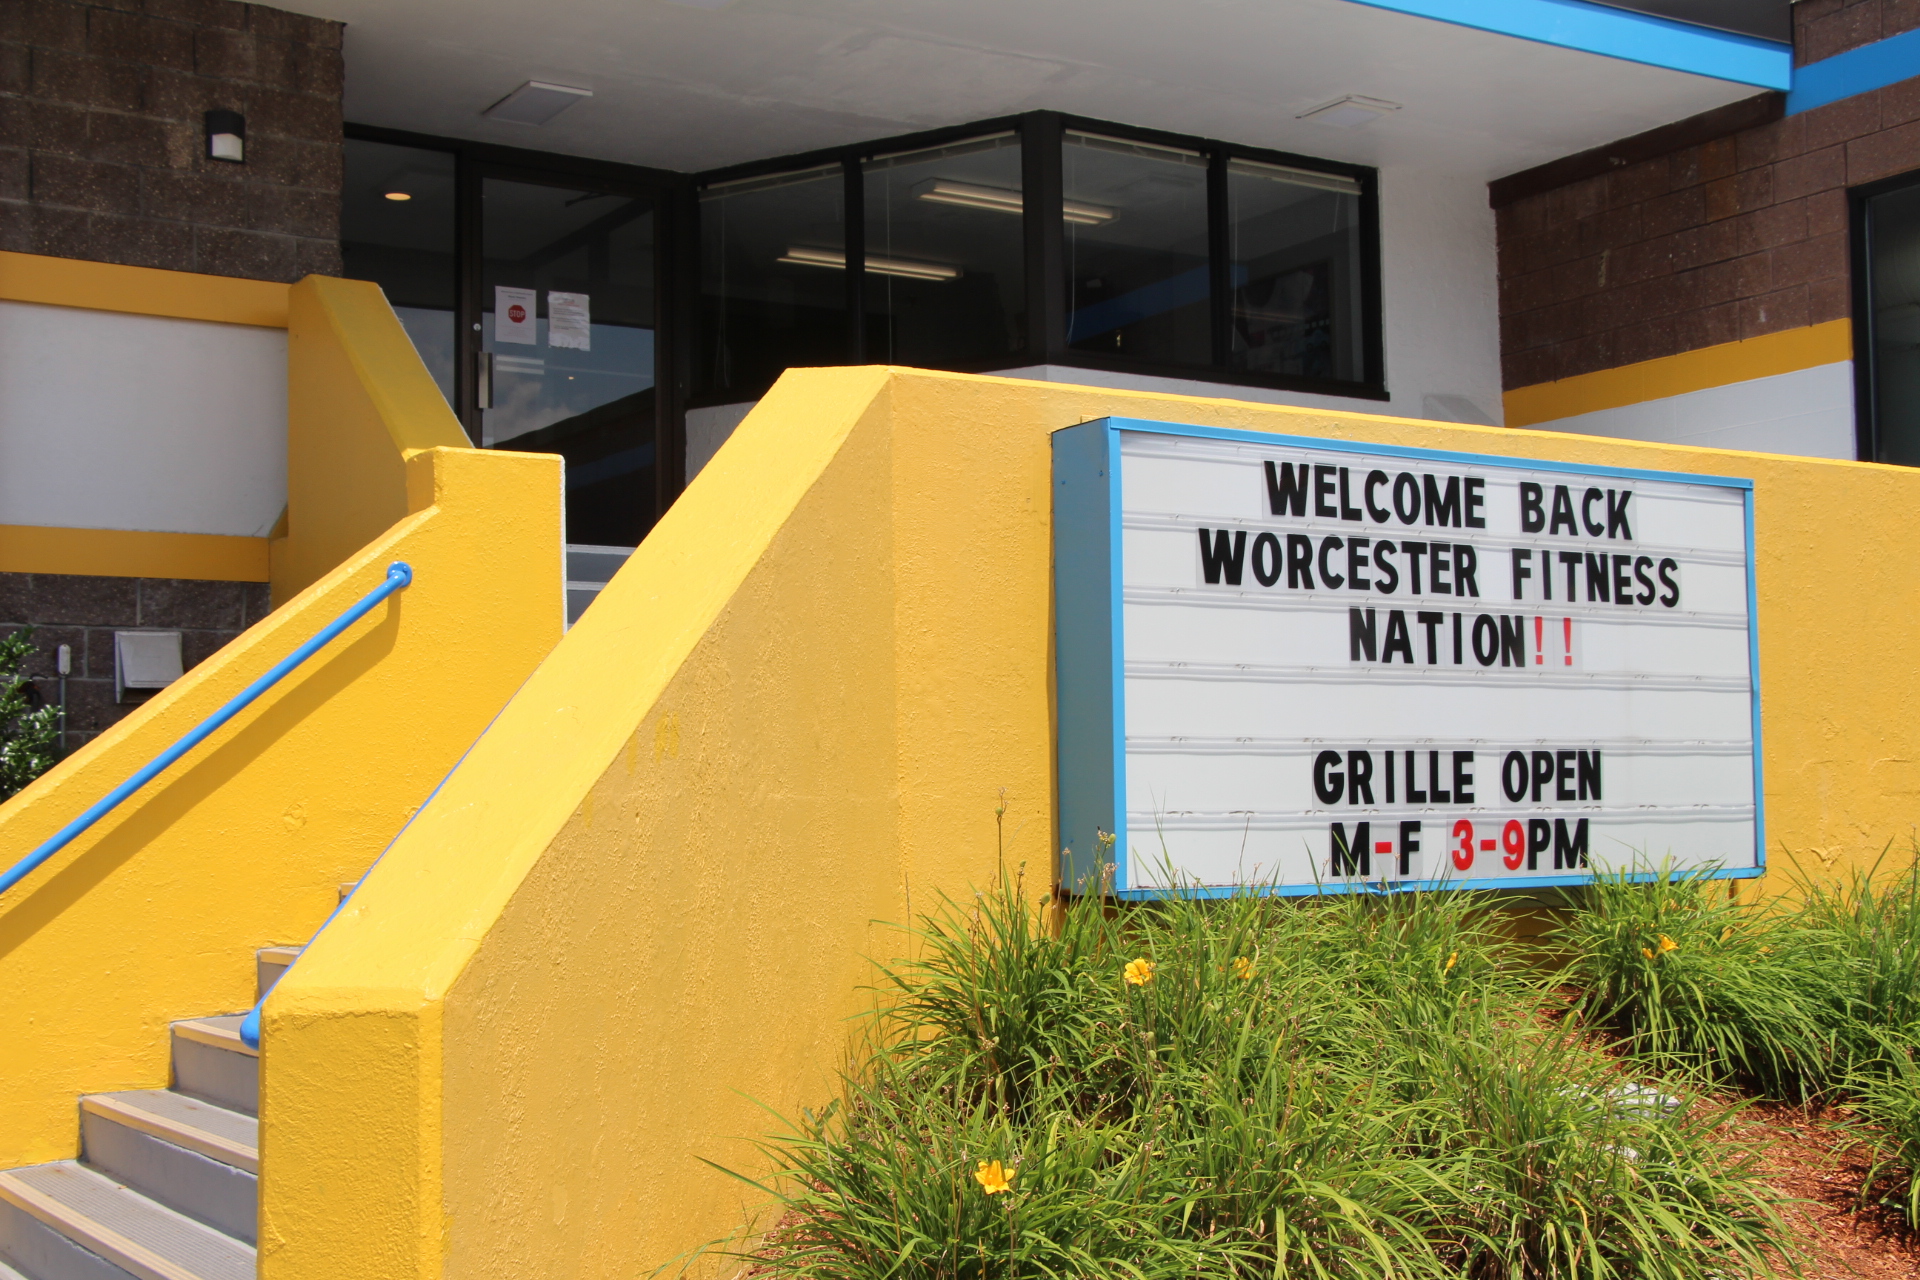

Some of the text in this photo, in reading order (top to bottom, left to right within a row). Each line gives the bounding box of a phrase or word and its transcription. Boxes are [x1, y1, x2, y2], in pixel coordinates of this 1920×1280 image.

[509, 310, 525, 318] STOP
[1264, 460, 1632, 540] WELCOME BACK
[1199, 528, 1680, 608] WORCESTER FITNESS
[1349, 606, 1573, 668] NATION!!
[1313, 748, 1601, 804] GRILLE OPEN
[1331, 818, 1588, 877] M-F 3-9PM
